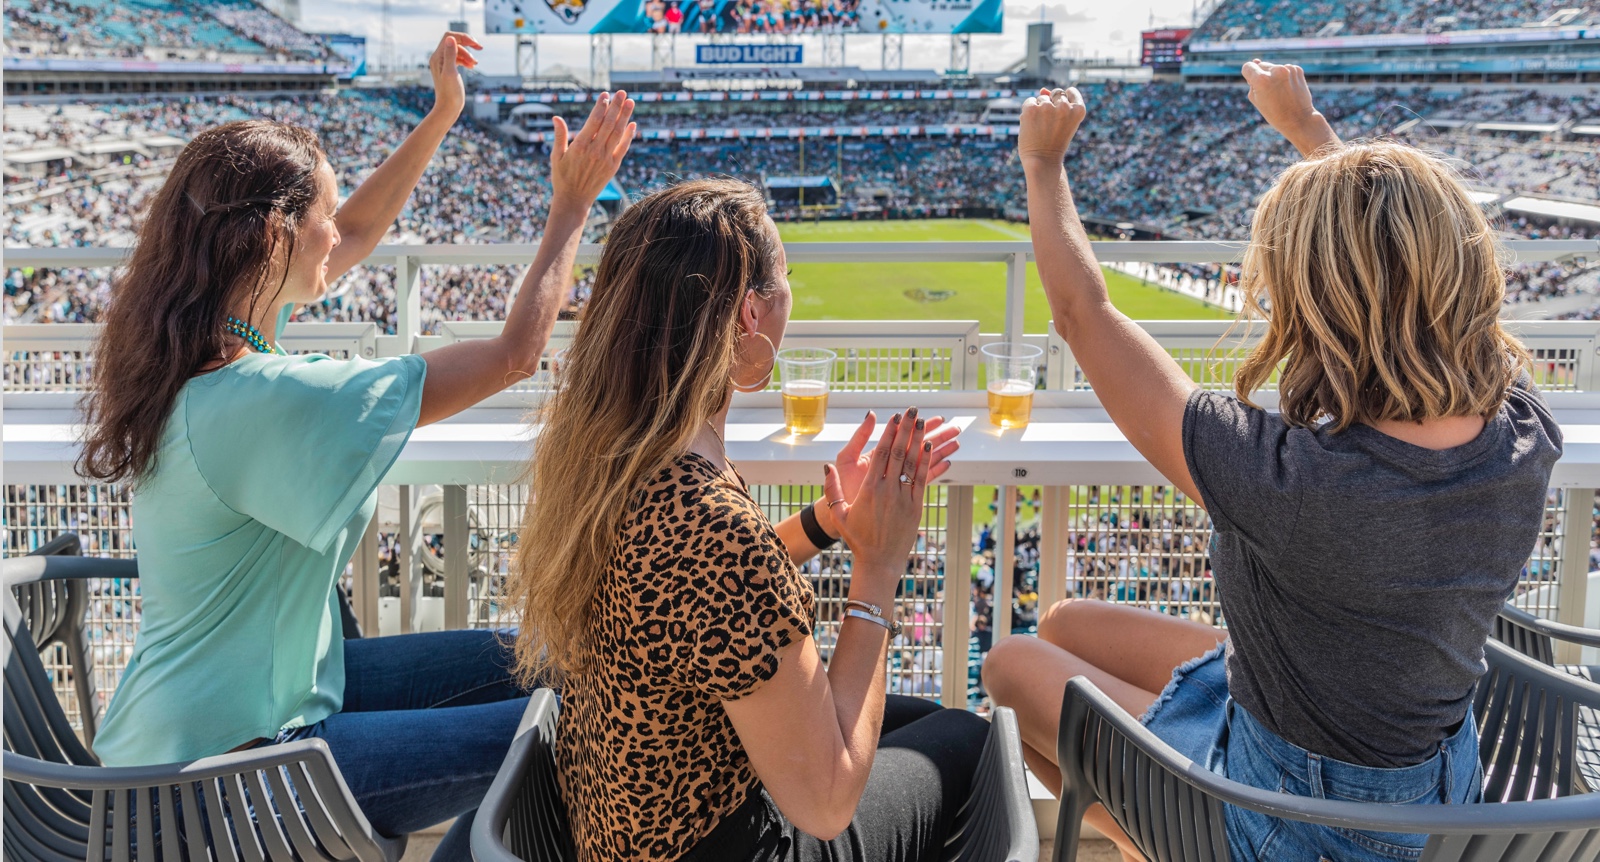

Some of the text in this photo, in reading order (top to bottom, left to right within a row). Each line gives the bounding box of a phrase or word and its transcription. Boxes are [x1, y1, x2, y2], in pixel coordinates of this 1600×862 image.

[701, 47, 799, 61] BUD LIGHT
[1015, 468, 1027, 477] 110
